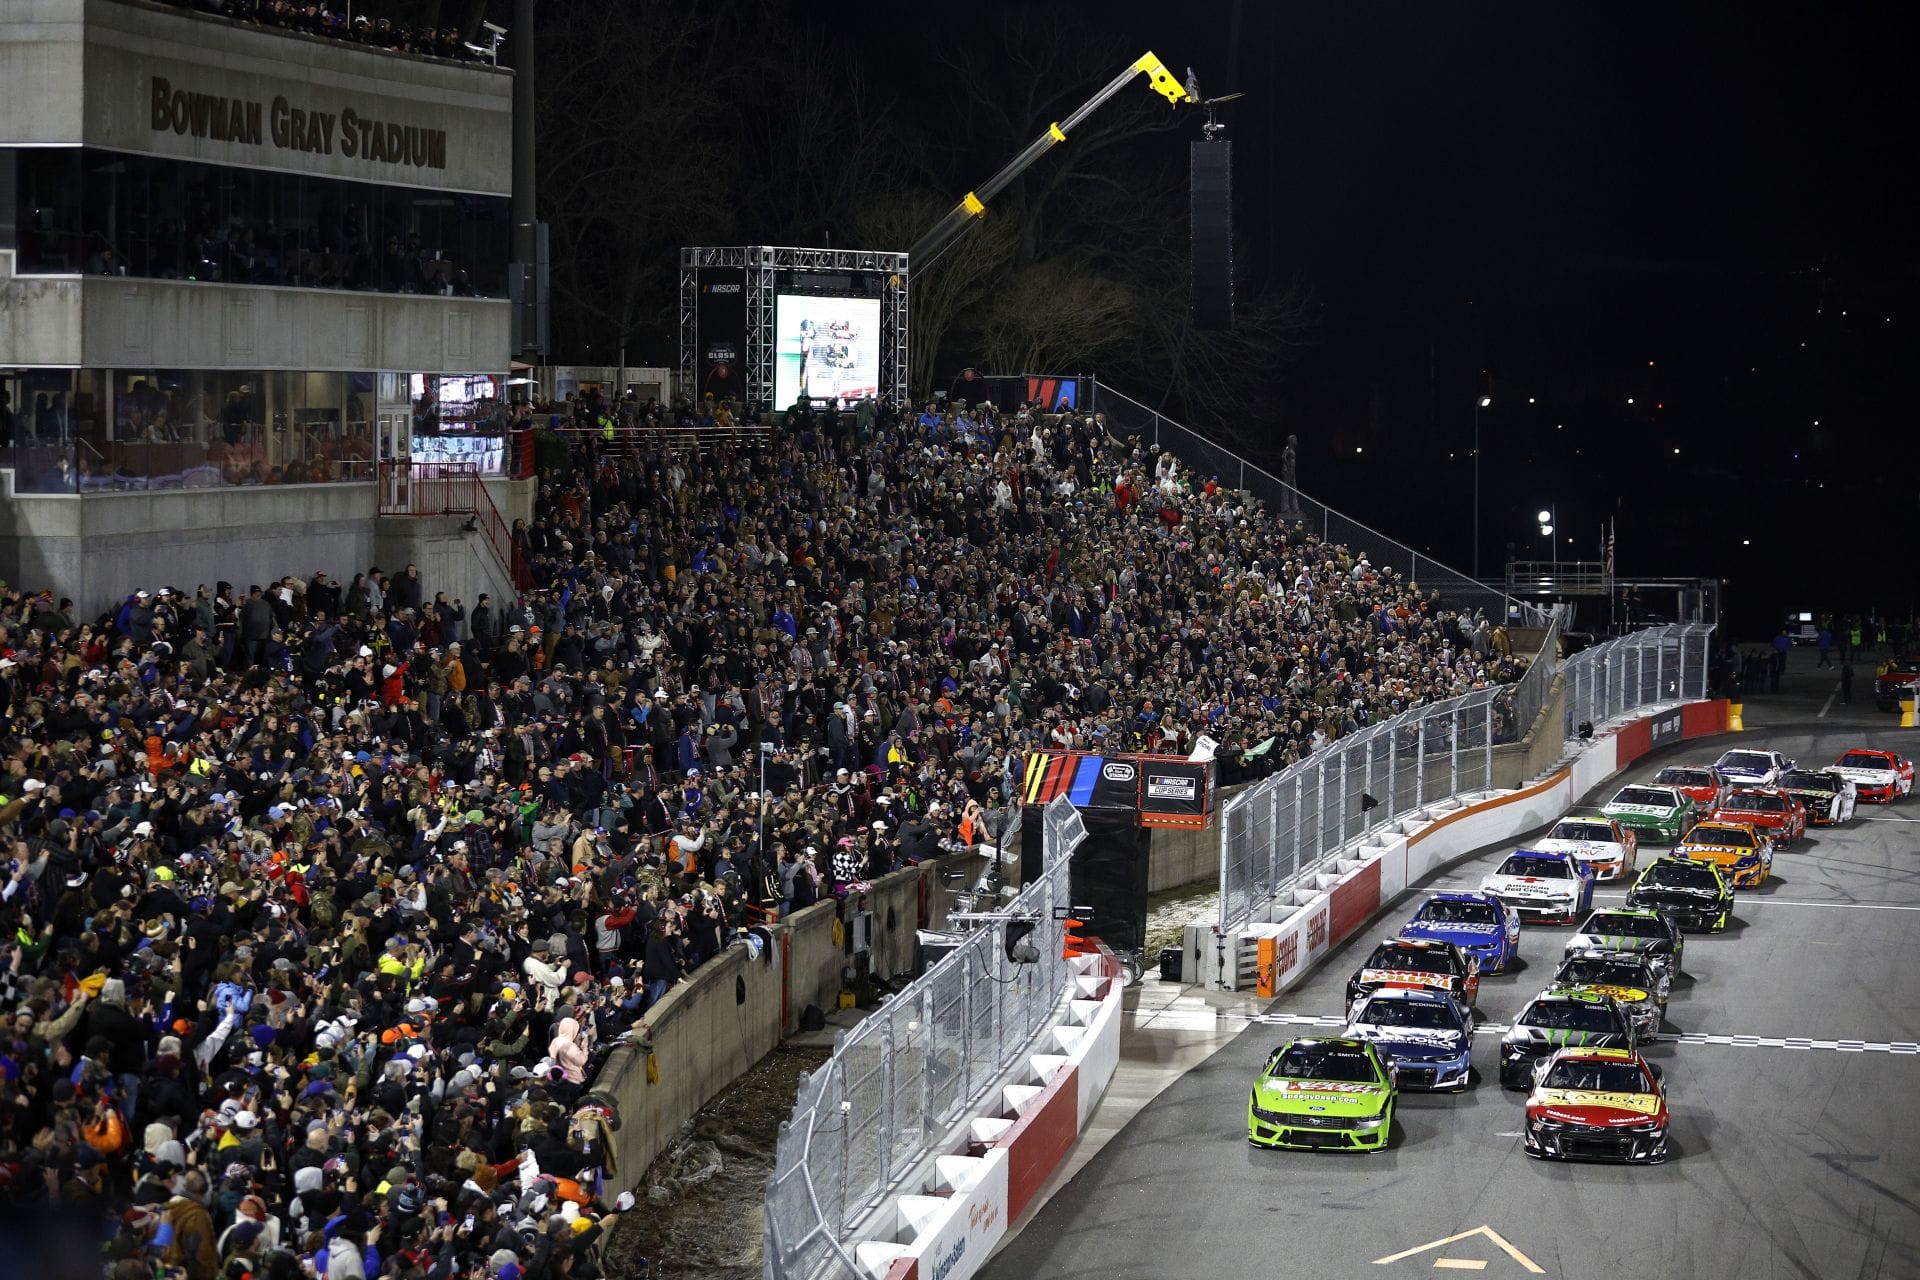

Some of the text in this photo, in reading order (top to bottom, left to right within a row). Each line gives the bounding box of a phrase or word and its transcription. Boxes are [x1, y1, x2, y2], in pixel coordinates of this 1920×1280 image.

[151, 76, 446, 169] BOWMAN GRAY STADIUM
[711, 284, 740, 293] NASCAR
[1163, 778, 1189, 786] NASCAR
[1281, 1093, 1358, 1104] SpeedyCash.com
[1546, 1109, 1649, 1123] seabest.com seabest.com
